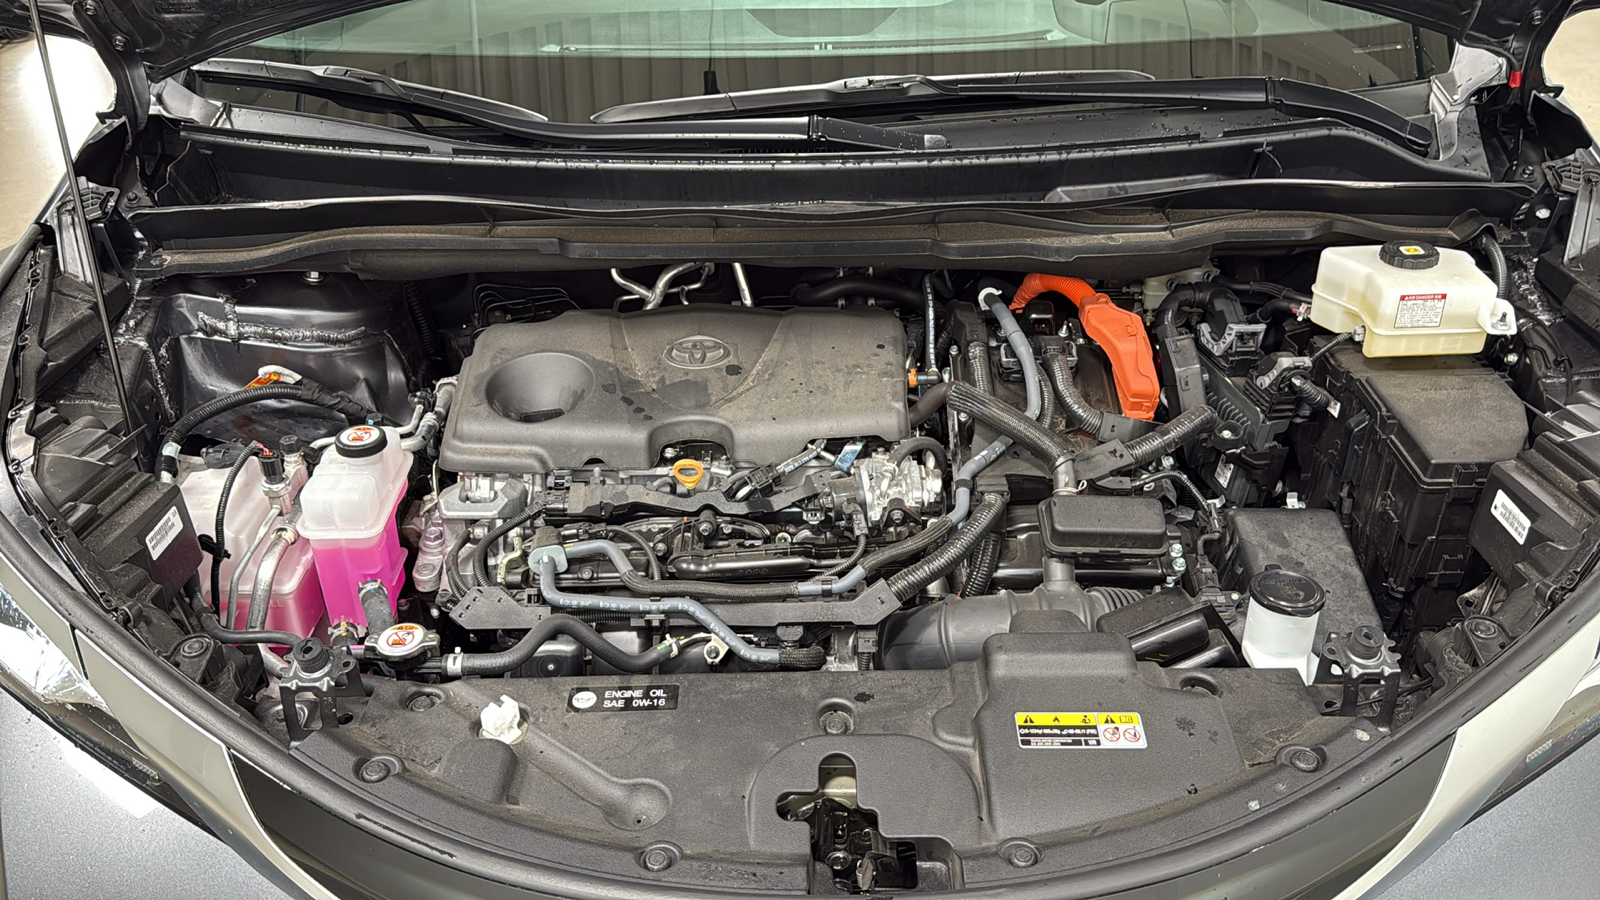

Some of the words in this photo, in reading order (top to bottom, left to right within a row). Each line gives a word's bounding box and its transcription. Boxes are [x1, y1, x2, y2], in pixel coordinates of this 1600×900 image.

[604, 690, 643, 698] ENGINE
[649, 689, 667, 697] OIL
[603, 699, 625, 708] SAE
[632, 698, 665, 707] 0W-16
